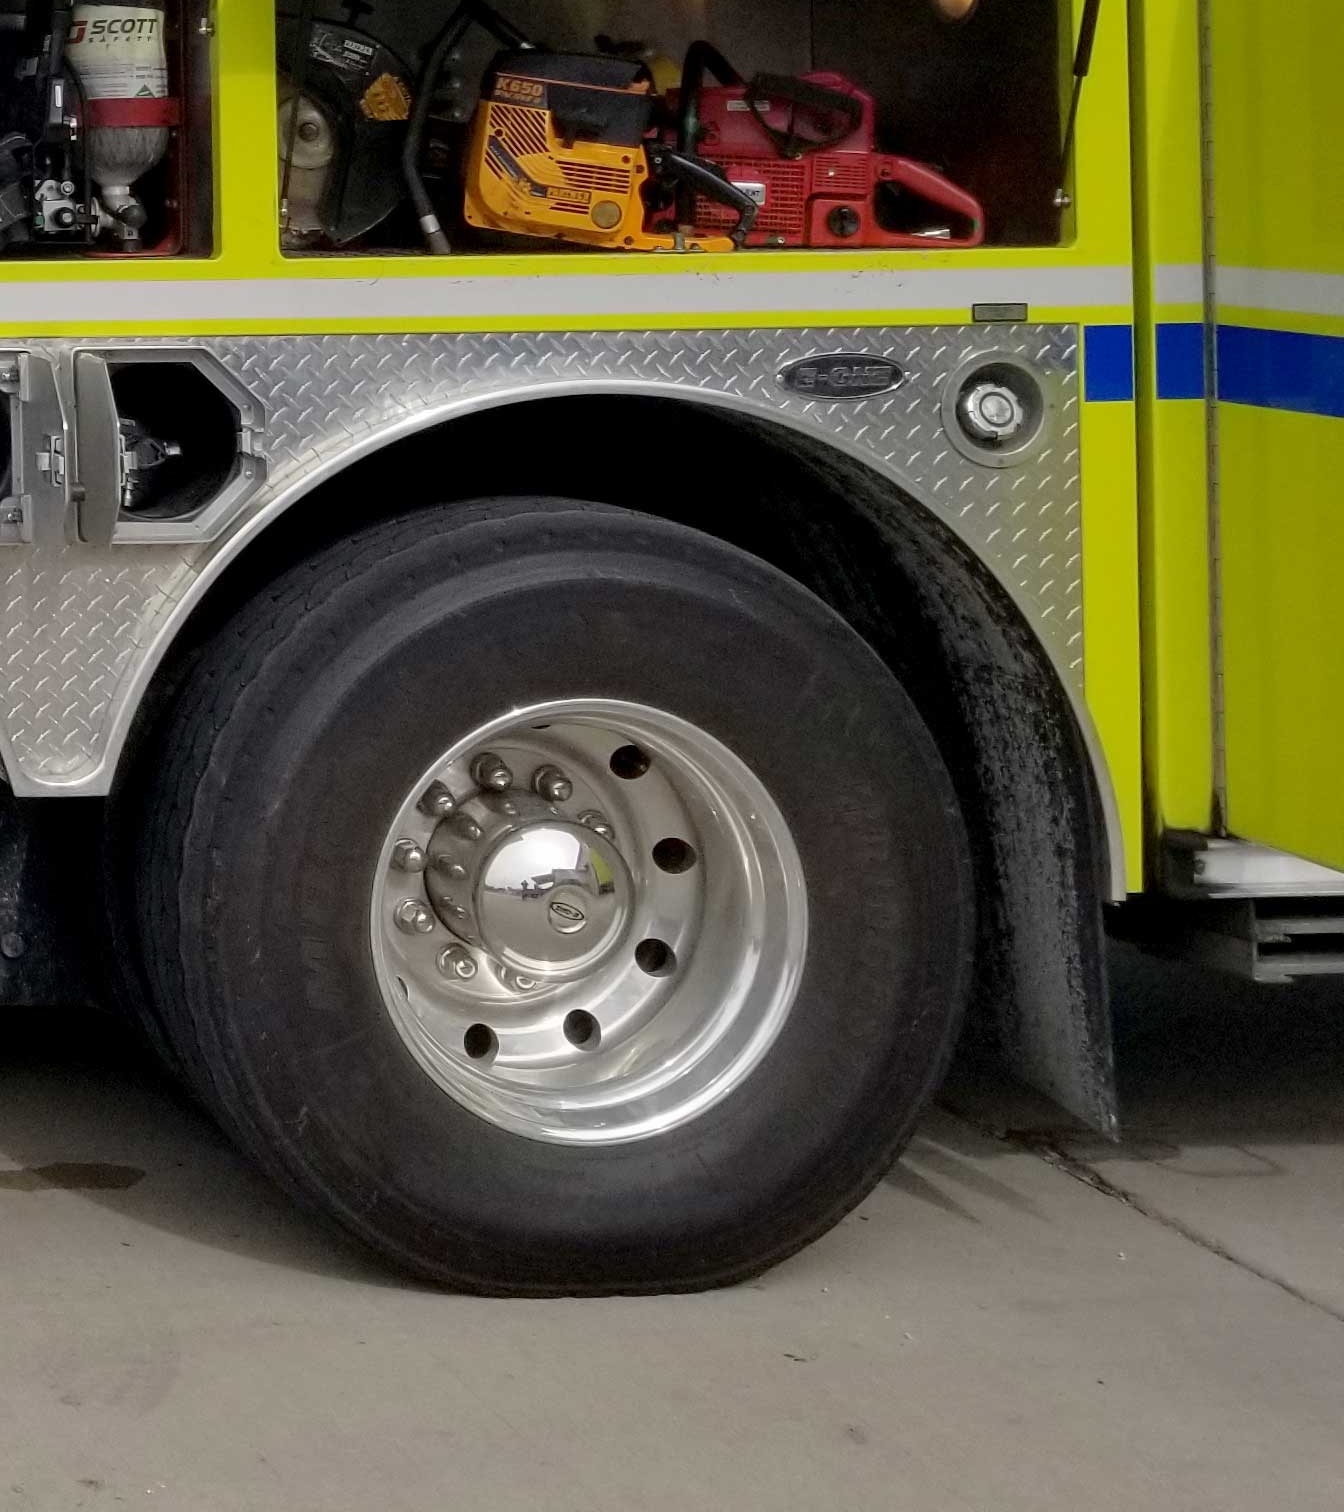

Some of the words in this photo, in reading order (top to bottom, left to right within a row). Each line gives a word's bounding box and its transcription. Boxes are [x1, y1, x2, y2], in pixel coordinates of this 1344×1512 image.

[90, 18, 158, 35] SCOTT
[88, 36, 153, 44] SAFETY
[496, 76, 544, 96] K650
